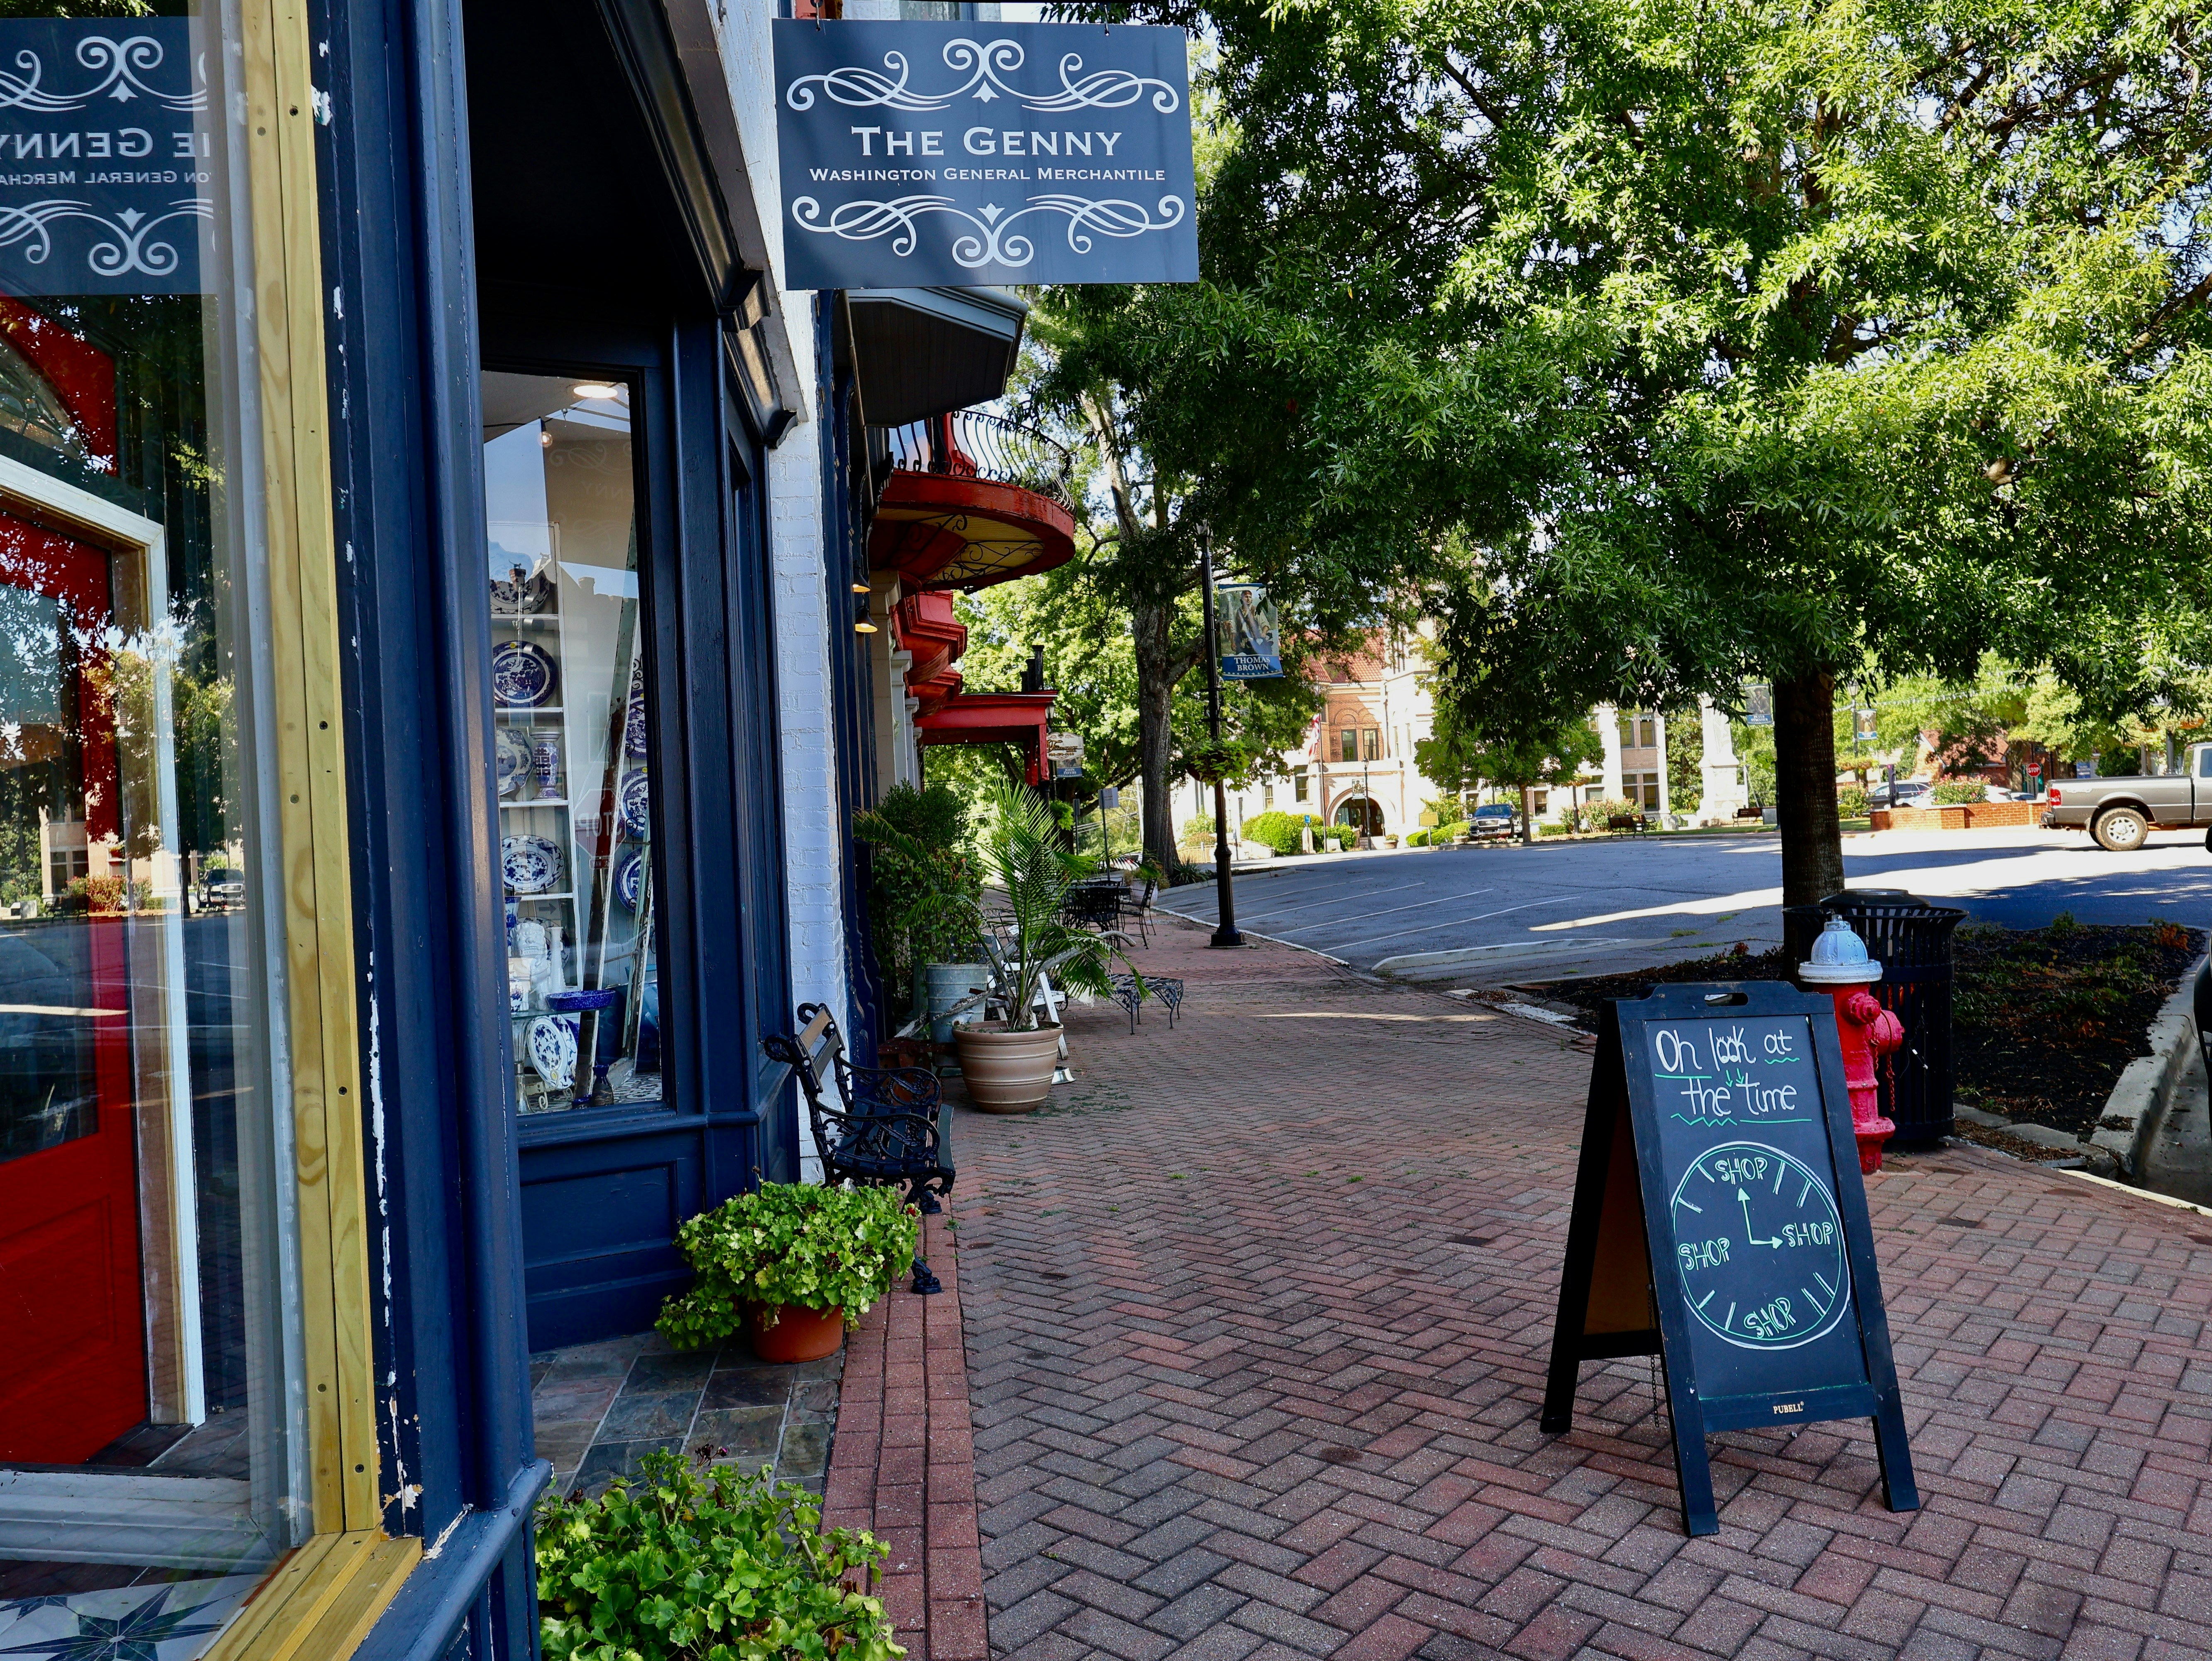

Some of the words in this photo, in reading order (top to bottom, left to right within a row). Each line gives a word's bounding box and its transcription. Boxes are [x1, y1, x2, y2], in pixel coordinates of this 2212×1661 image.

[851, 125, 944, 157] THE
[963, 126, 1123, 157] GENNY
[809, 168, 936, 182] WASHINGTON
[943, 167, 1030, 181] GENERAL
[1037, 167, 1165, 181] MERCHANTILE
[1234, 657, 1270, 665] THOMAS
[1237, 663, 1269, 672] BROWN
[1655, 1029, 1702, 1073] Oh
[1709, 1026, 1757, 1071] look
[1764, 1029, 1793, 1055] at
[1681, 1078, 1731, 1117] the
[1735, 1073, 1797, 1115] time
[1714, 1157, 1768, 1184] SHOP
[1781, 1222, 1833, 1247] SHOP
[1678, 1237, 1730, 1270] SHOP
[1743, 1297, 1796, 1339] SHOP
